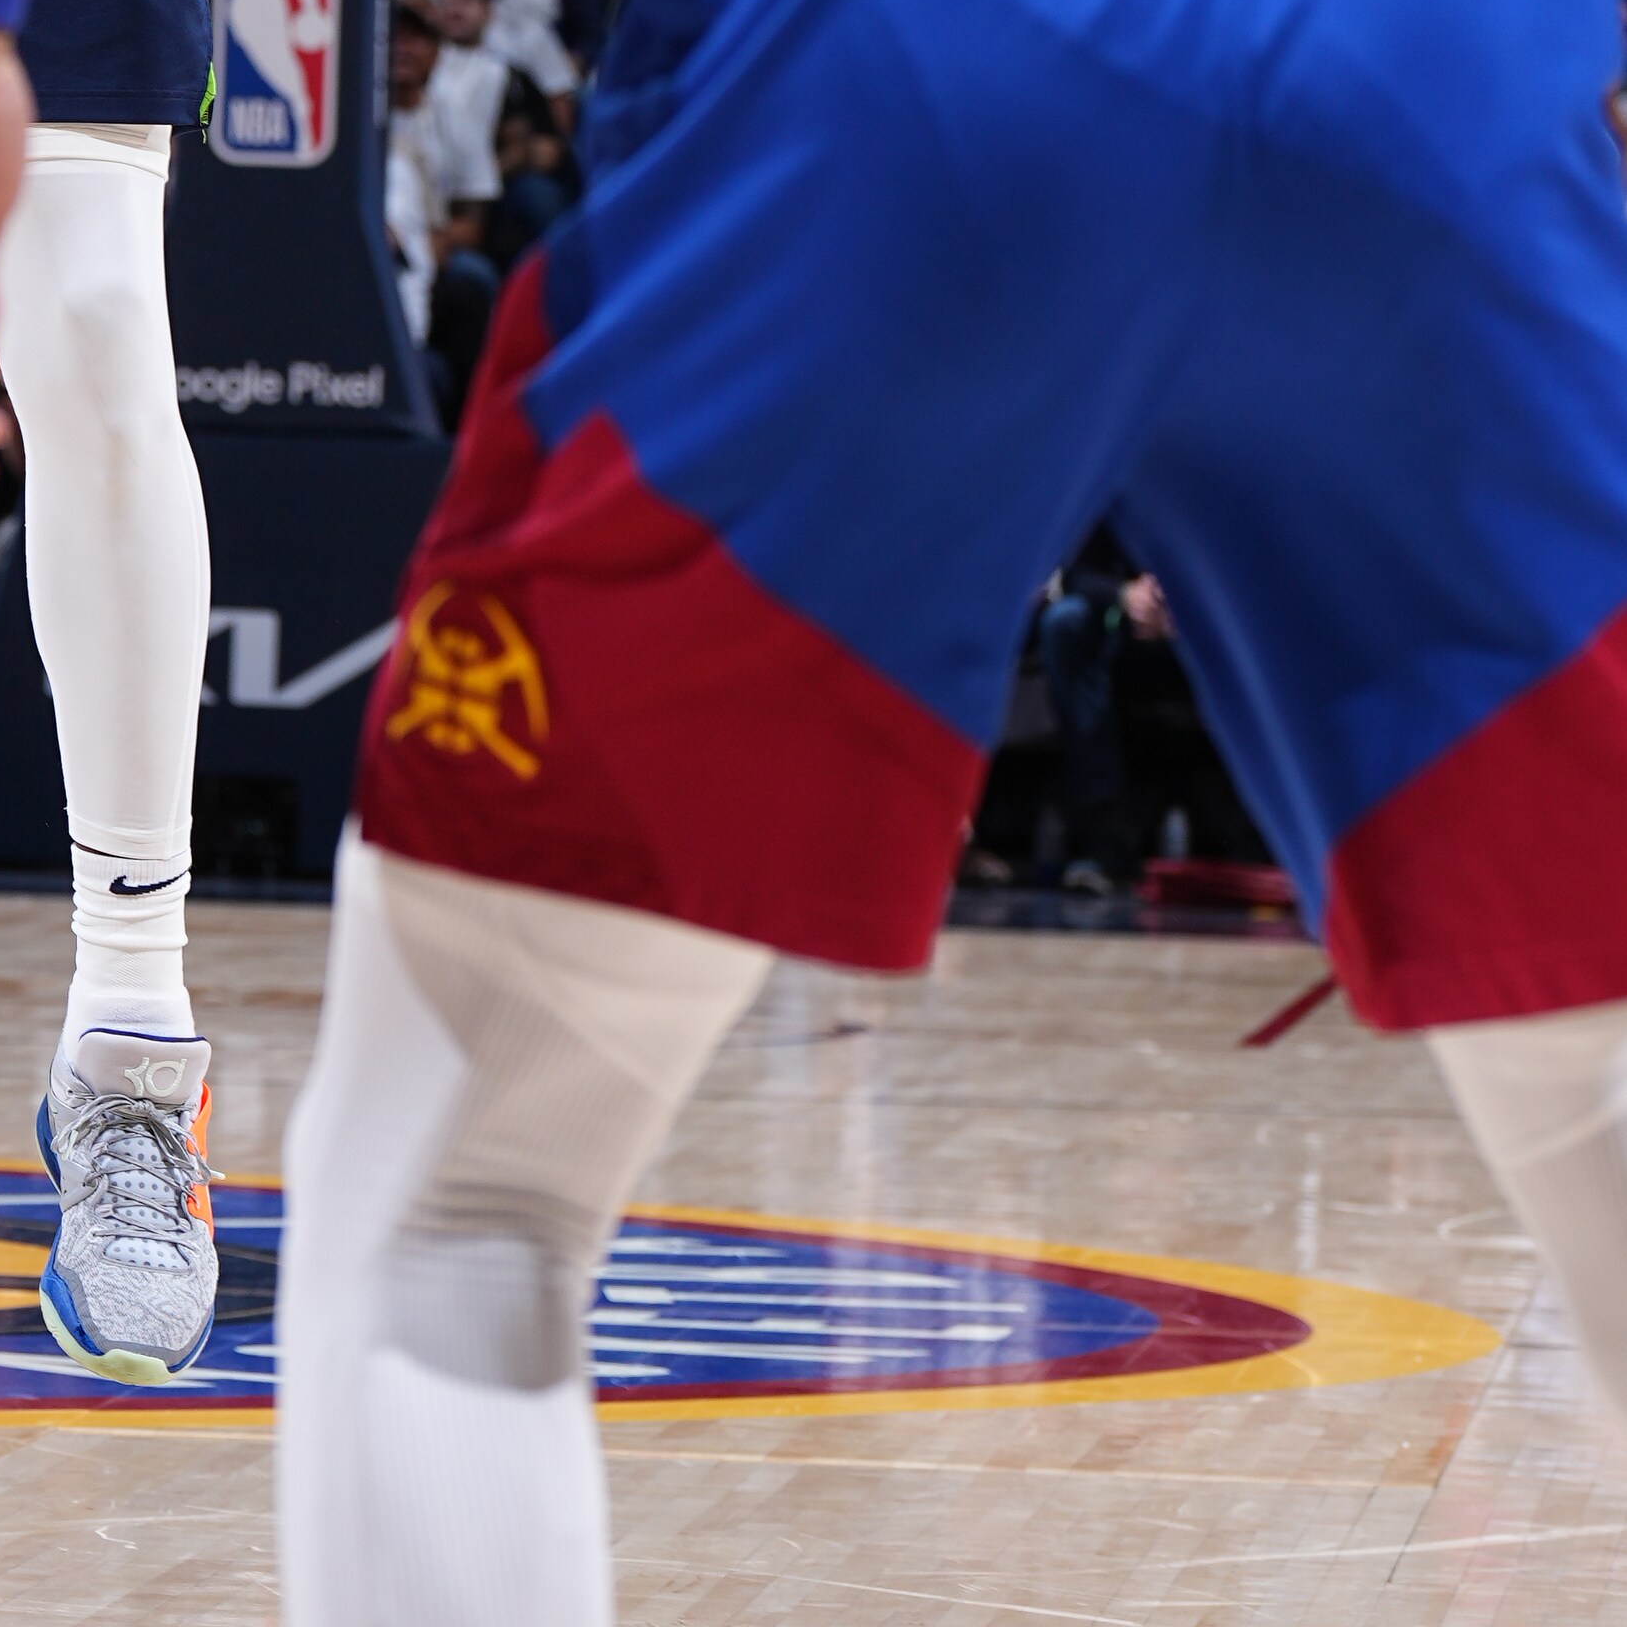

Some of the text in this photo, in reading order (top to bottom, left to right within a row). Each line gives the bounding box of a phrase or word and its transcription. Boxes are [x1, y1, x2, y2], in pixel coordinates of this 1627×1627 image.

[228, 96, 289, 145] NBA
[176, 359, 386, 414] oogle Pixel
